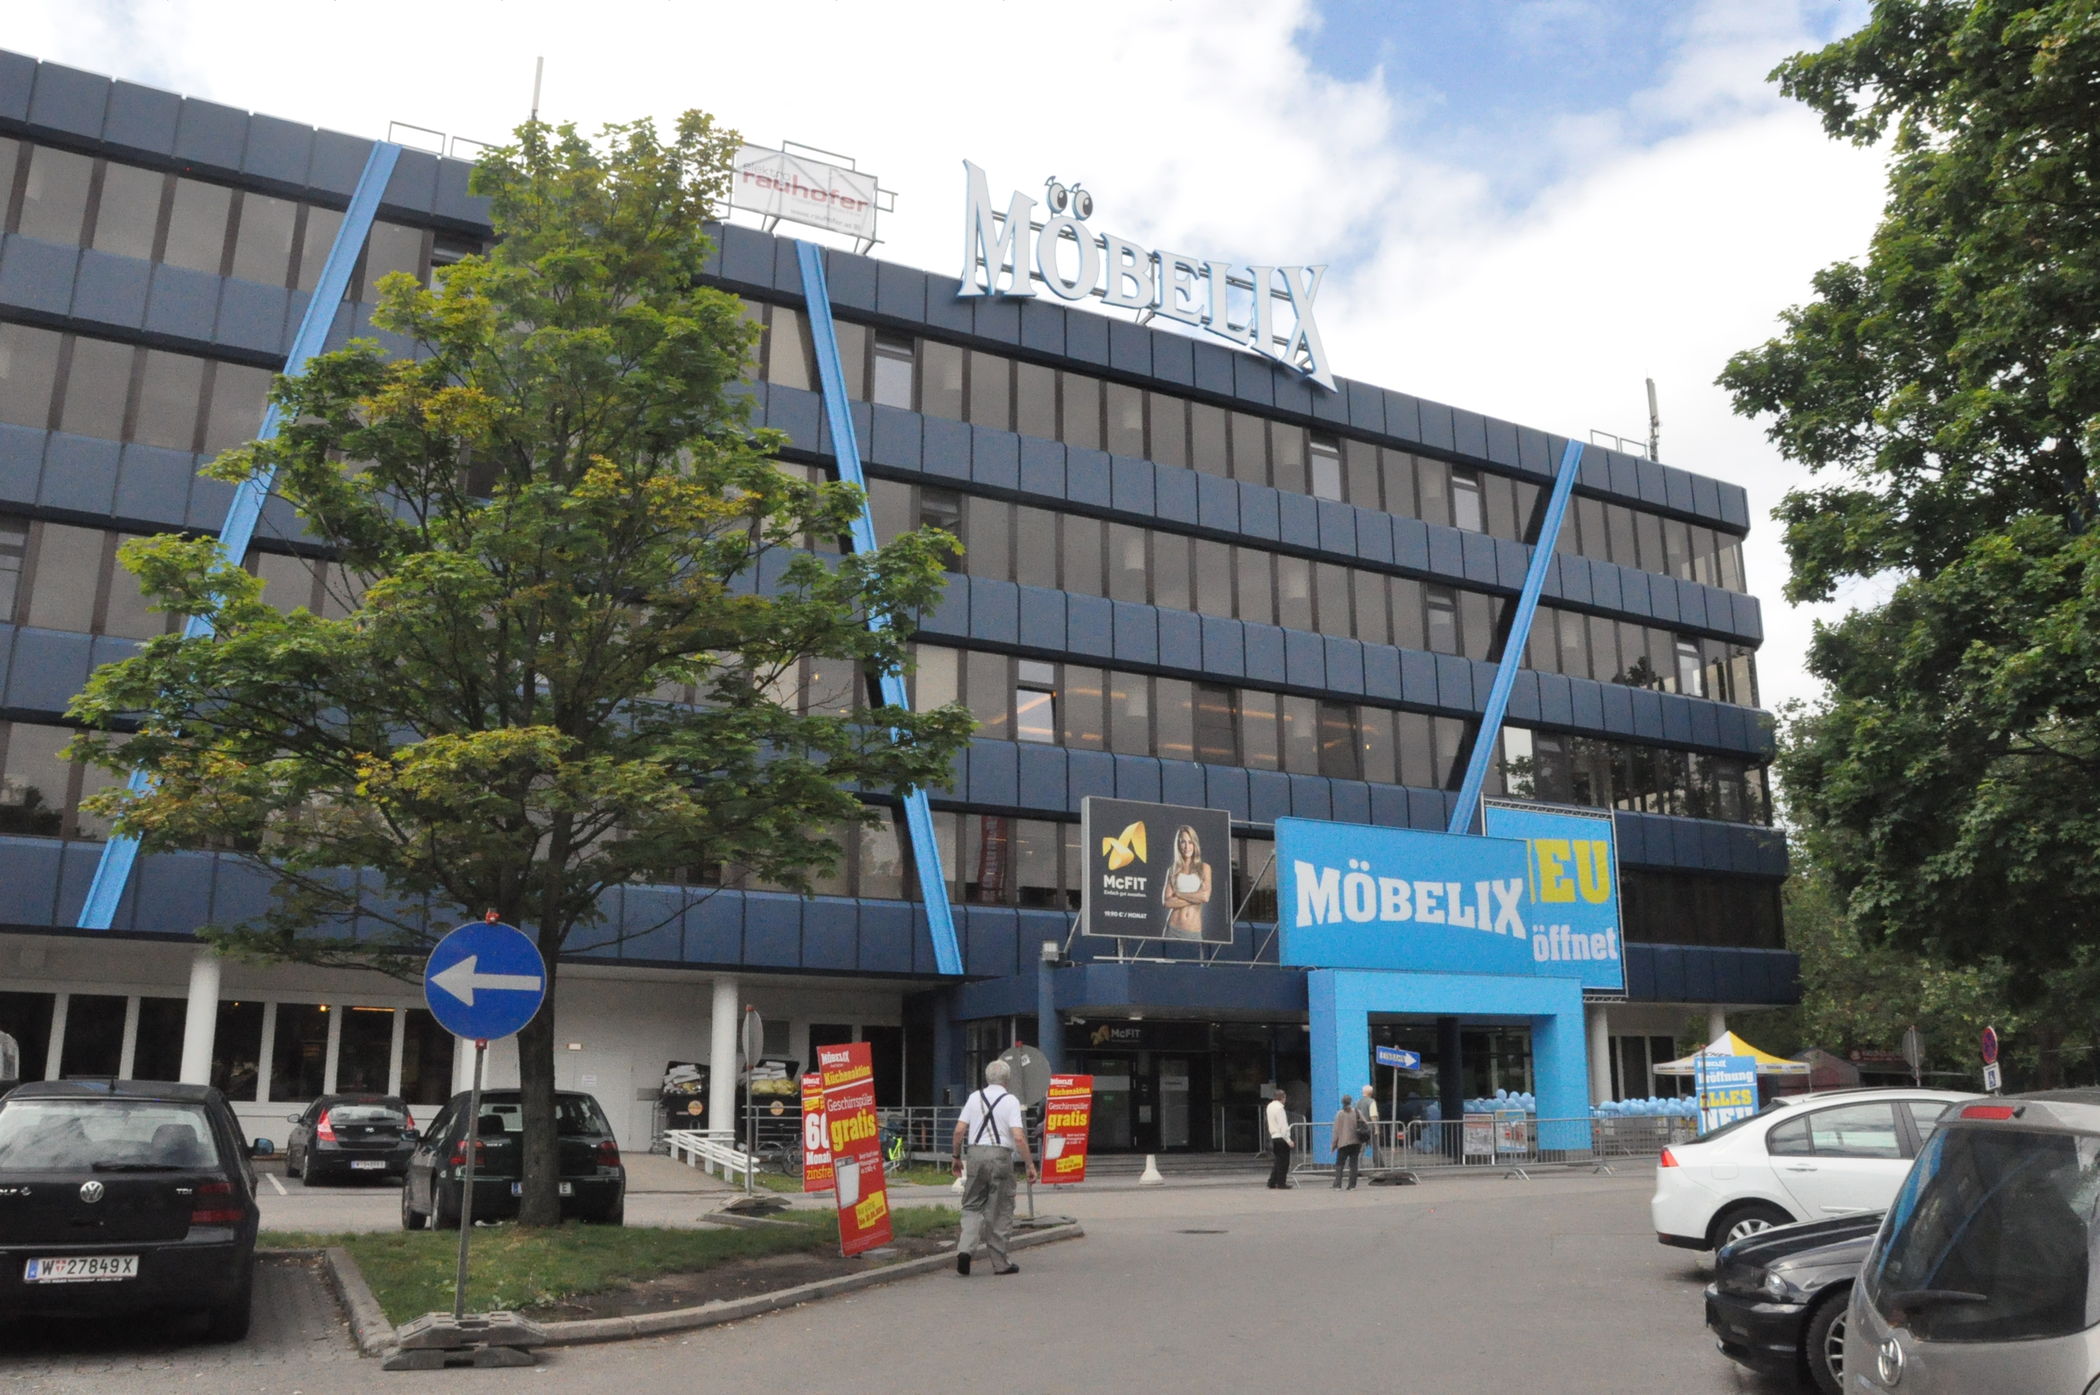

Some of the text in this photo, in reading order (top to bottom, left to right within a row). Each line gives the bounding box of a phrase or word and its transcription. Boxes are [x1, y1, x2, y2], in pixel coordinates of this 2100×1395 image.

[742, 171, 869, 213] rauhofer
[957, 158, 1338, 393] MÖBELIX
[1103, 874, 1147, 891] McFIT
[1526, 838, 1611, 905] EU
[1294, 858, 1527, 940] MÖBELIX
[1532, 924, 1618, 962] öffnet
[1111, 1029, 1141, 1038] McFIT
[823, 1065, 871, 1086] Küchenaktion
[827, 1094, 873, 1112] Geschirrspüler
[830, 1108, 877, 1152] gratis
[1047, 1110, 1088, 1131] gratis
[42, 1260, 55, 1276] W
